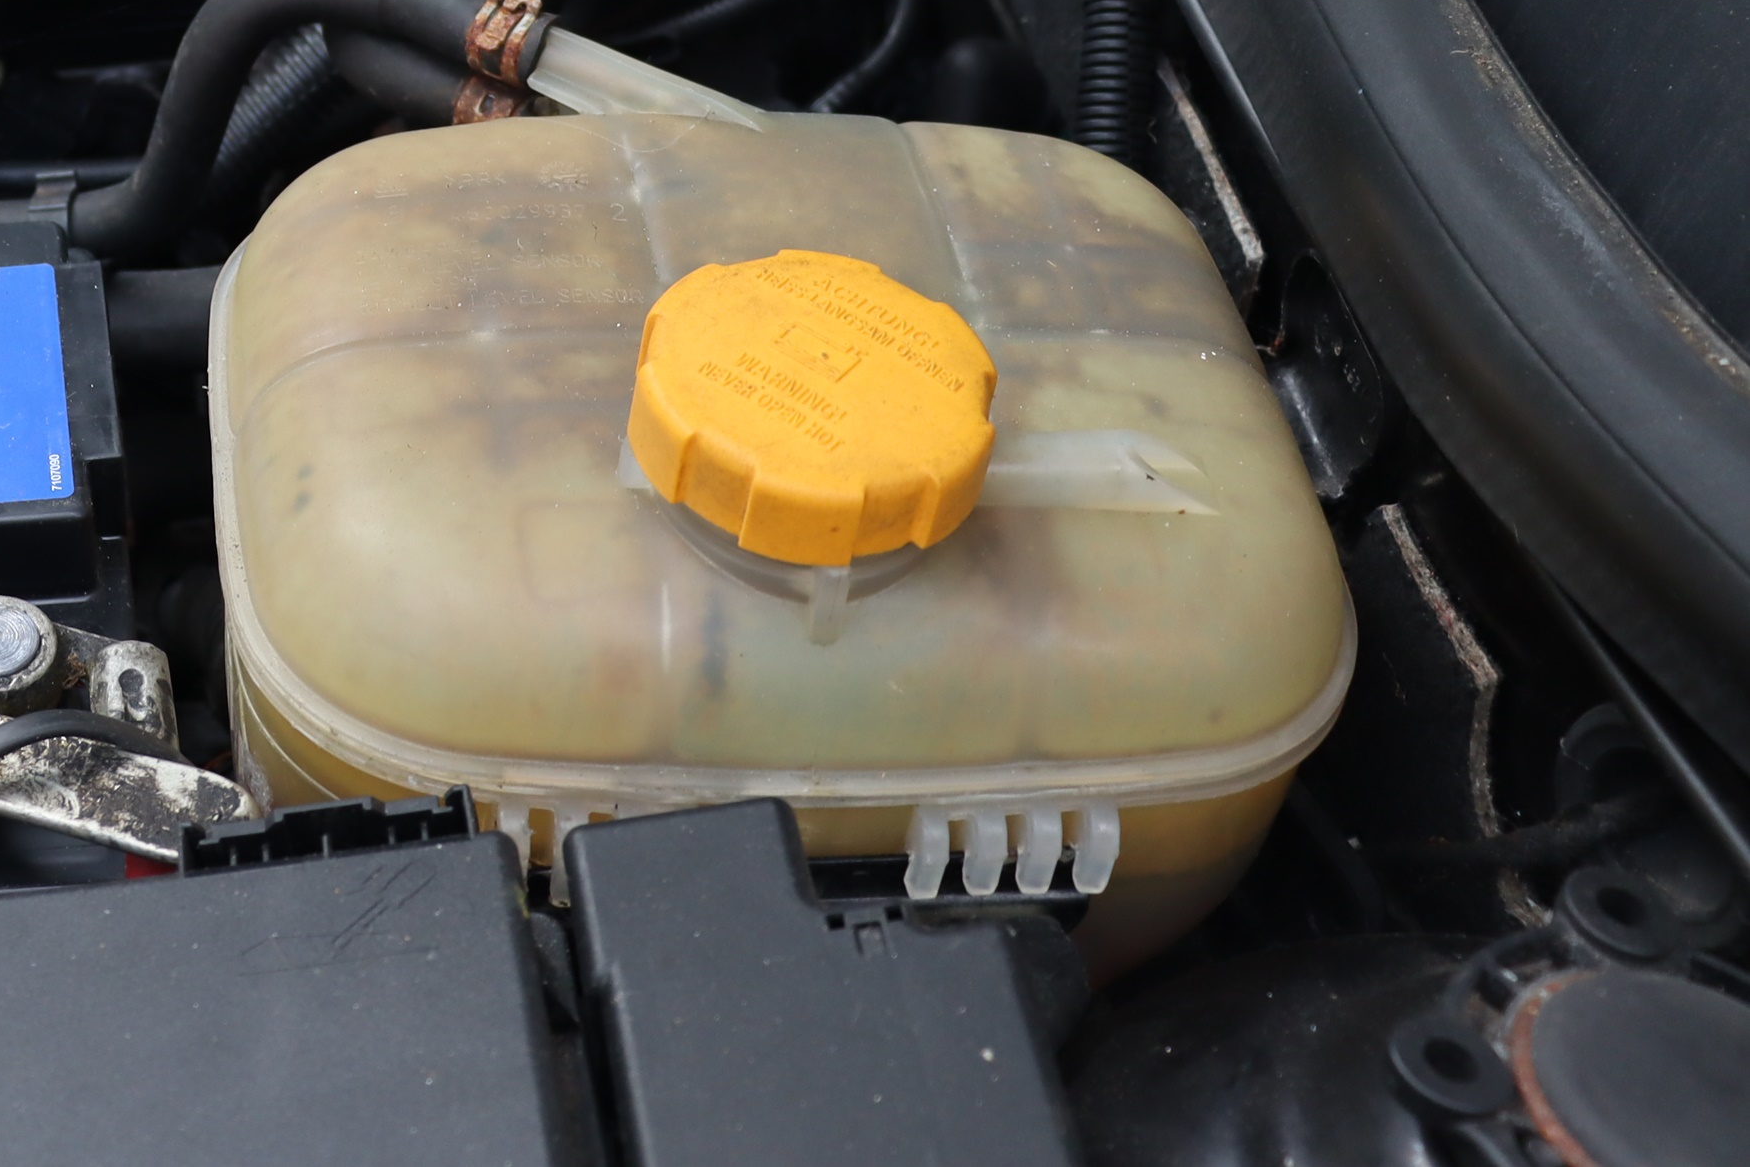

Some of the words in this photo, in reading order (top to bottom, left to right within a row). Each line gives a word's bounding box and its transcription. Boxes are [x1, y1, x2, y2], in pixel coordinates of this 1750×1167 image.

[556, 286, 646, 306] SENSOR
[813, 277, 940, 350] ACHTUNG!
[698, 361, 757, 399] NEVER
[757, 393, 807, 429] OPEN
[804, 421, 845, 452] HOT
[736, 352, 848, 425] WARNING!
[49, 454, 63, 492] 7107090
